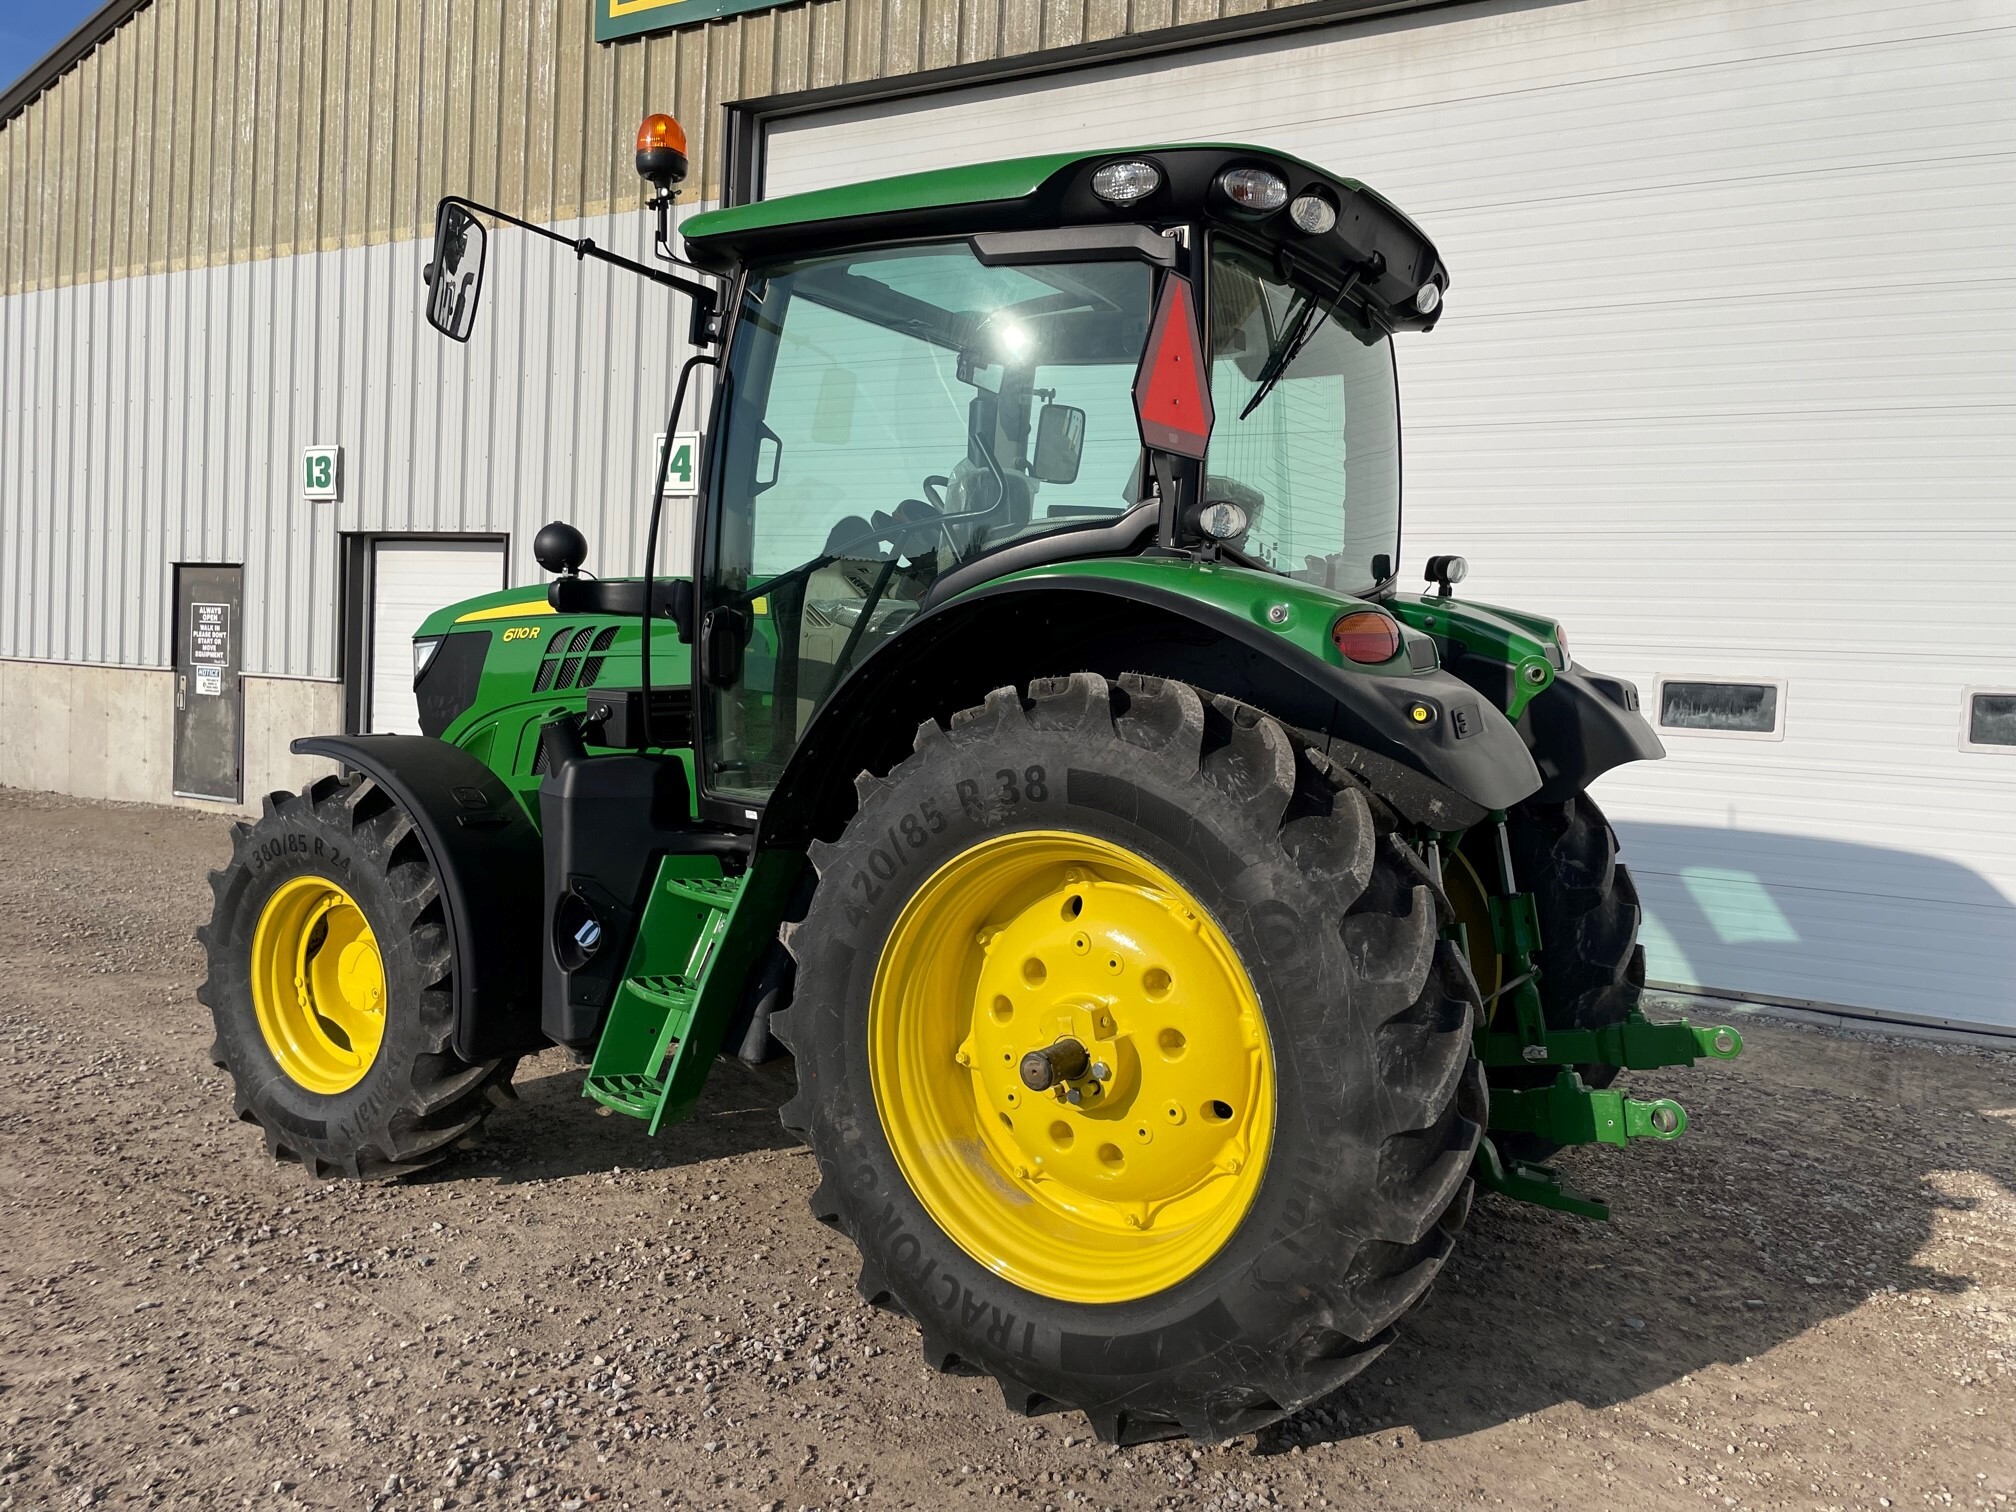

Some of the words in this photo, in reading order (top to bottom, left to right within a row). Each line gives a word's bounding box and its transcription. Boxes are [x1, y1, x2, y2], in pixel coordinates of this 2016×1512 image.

[306, 455, 332, 488] 13
[199, 606, 222, 615] ALWAYS
[193, 630, 211, 638] PLEASE
[211, 631, 227, 639] DON'T
[195, 650, 224, 658] EQUIPMENT
[198, 669, 219, 677] NOTICE
[994, 764, 1049, 807] 38
[252, 833, 308, 869] 380/85
[314, 836, 324, 858] R
